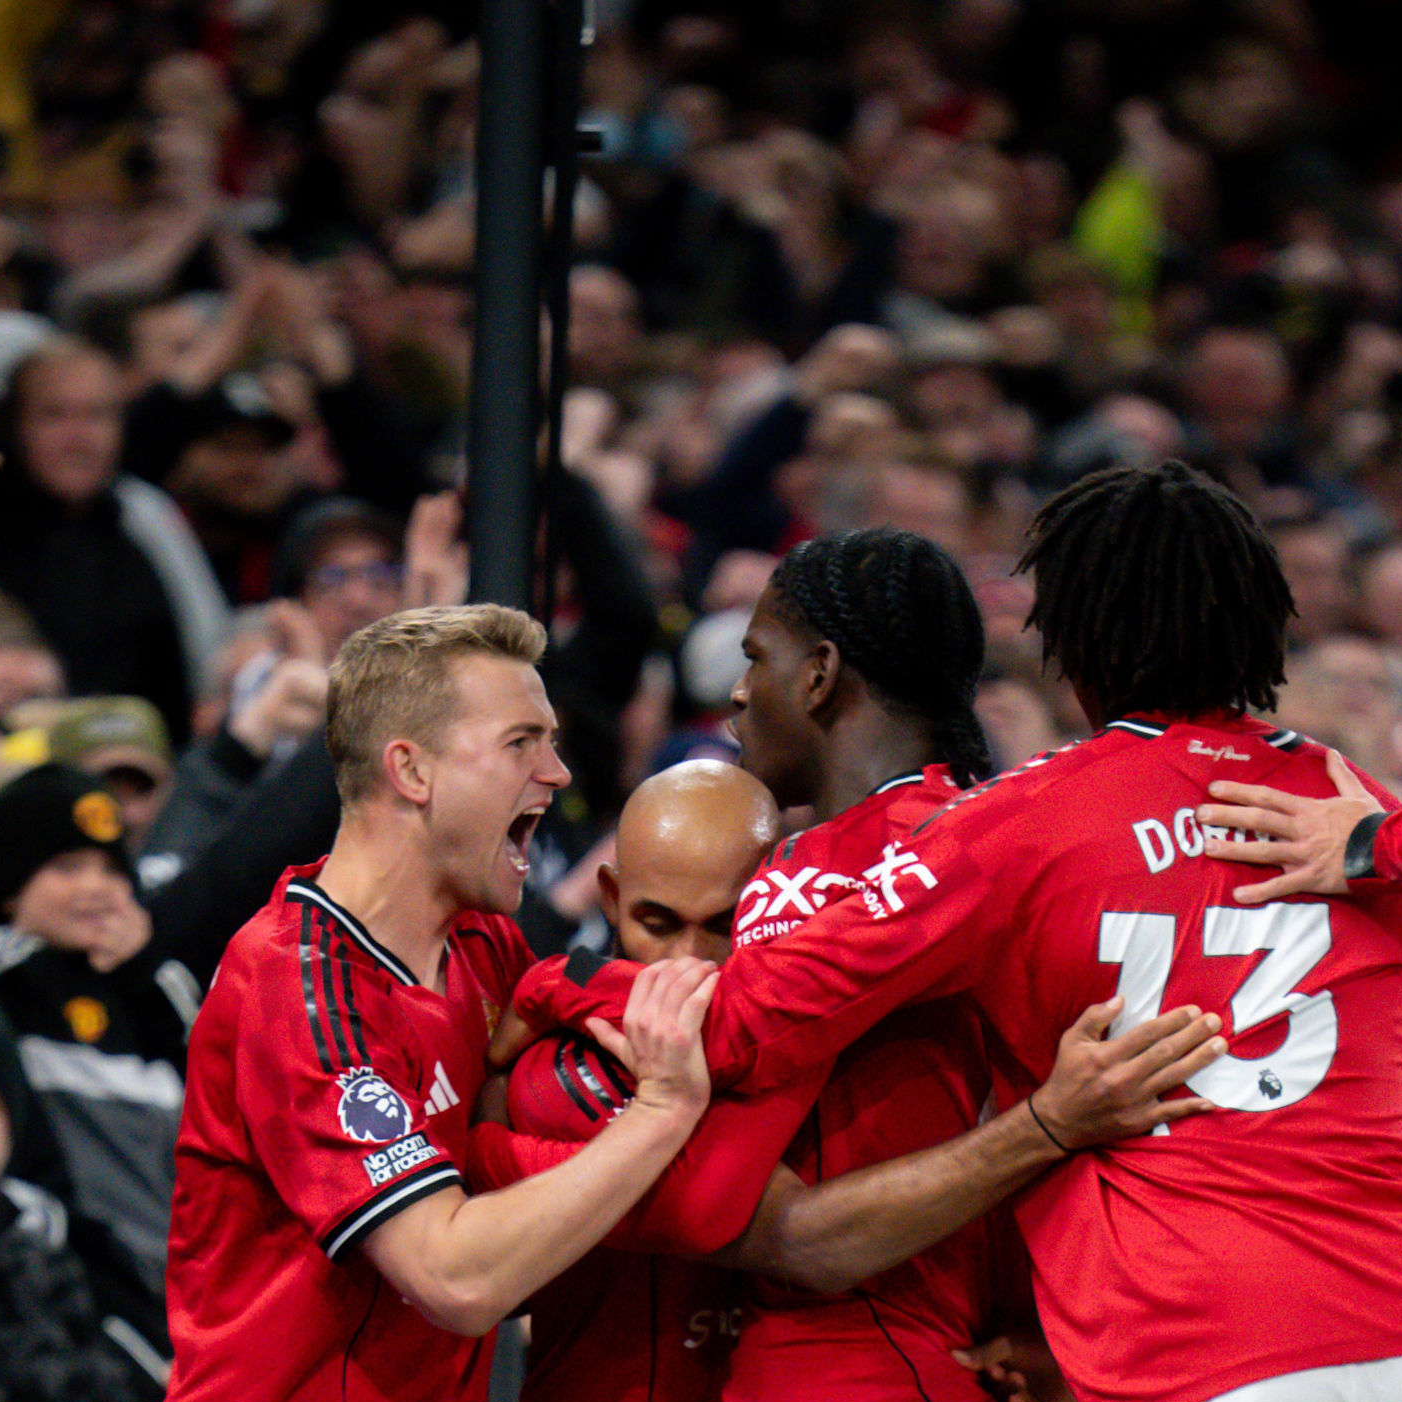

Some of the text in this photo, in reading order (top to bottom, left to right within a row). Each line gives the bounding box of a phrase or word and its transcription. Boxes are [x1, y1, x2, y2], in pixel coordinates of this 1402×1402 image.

[1098, 901, 1340, 1136] 13
[362, 1134, 428, 1173] No room
[392, 1145, 440, 1174] racism
